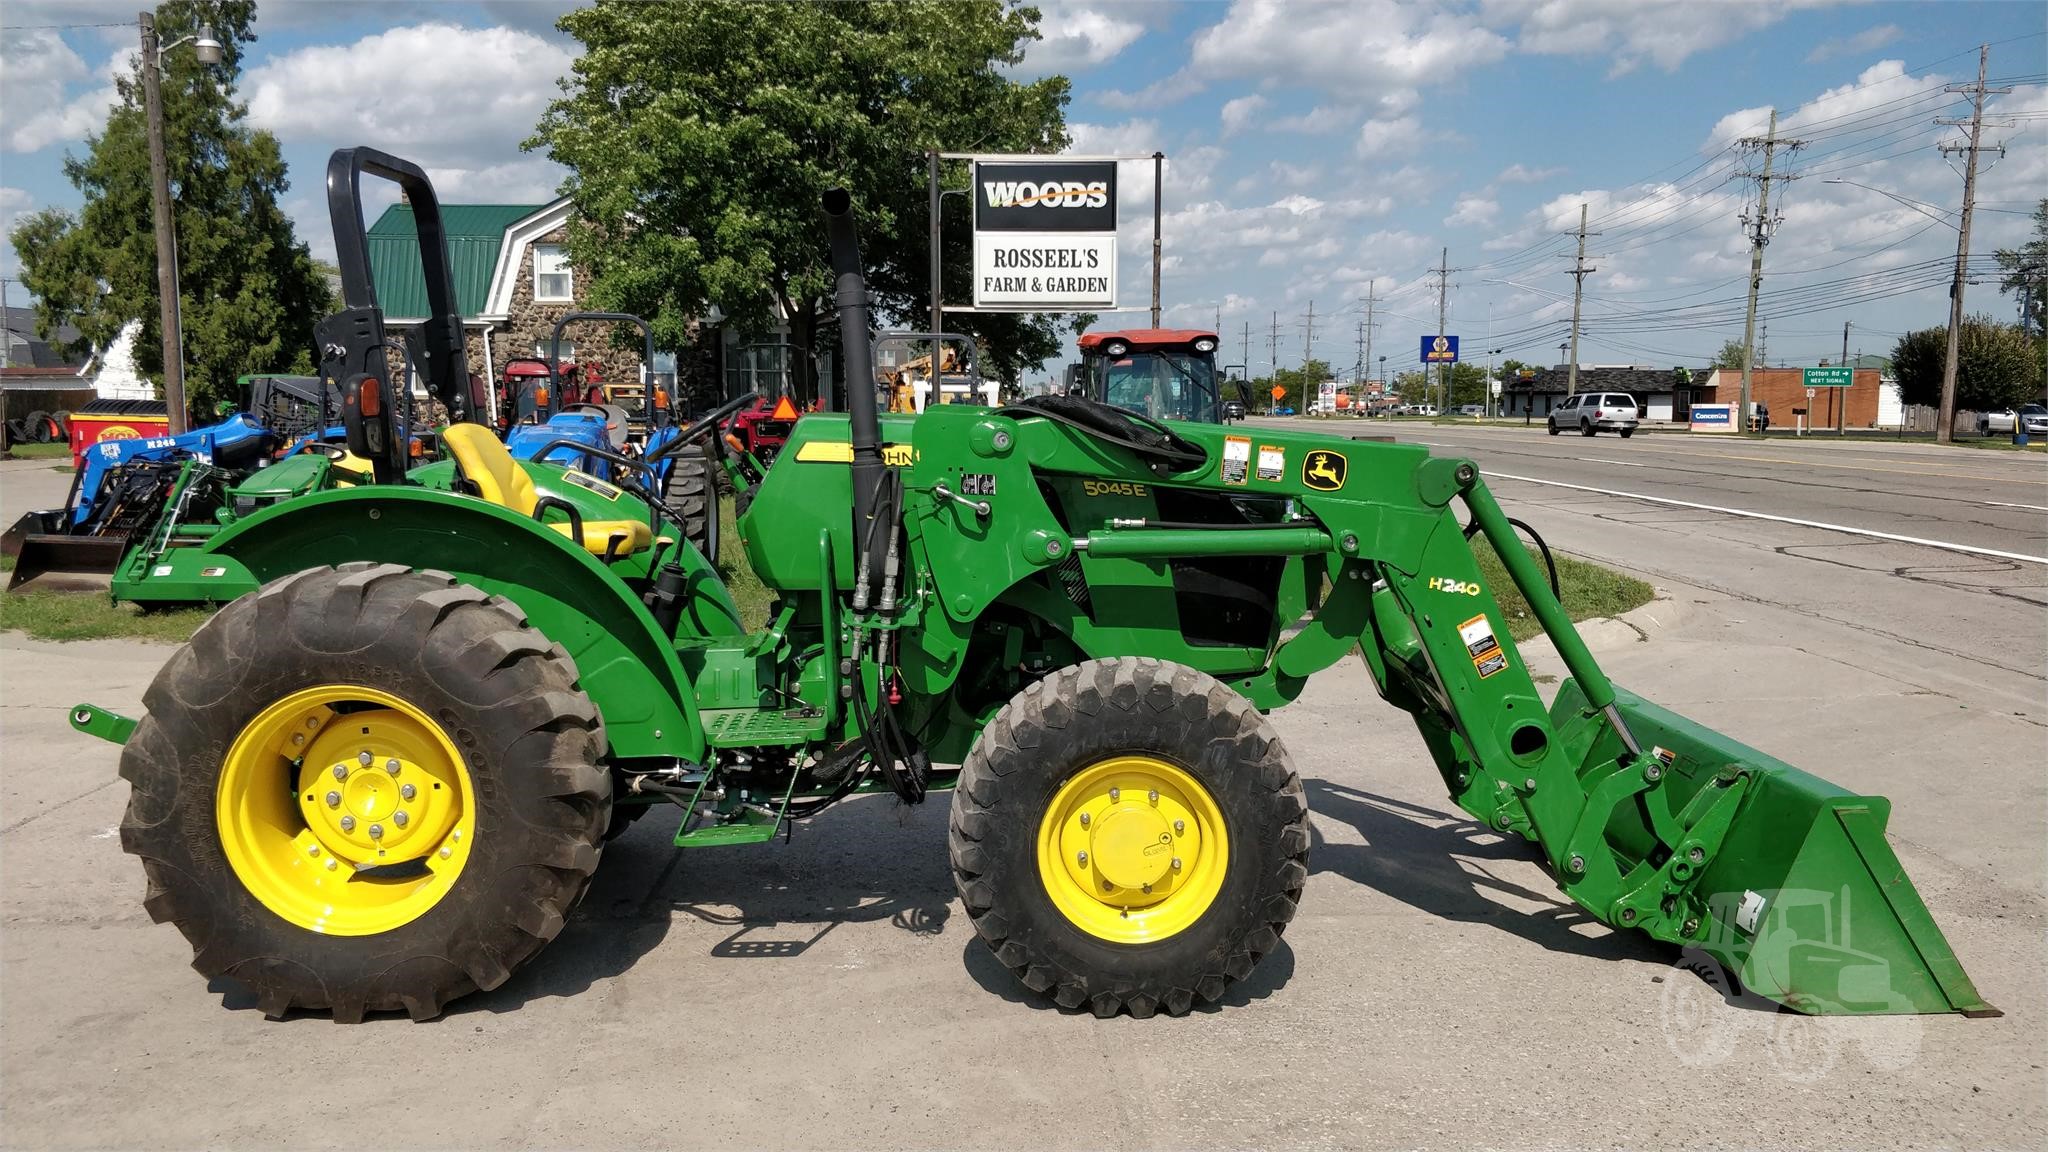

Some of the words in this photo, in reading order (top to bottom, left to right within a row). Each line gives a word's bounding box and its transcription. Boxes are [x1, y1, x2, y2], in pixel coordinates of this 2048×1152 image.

[984, 182, 1107, 208] WOODS
[993, 248, 1099, 268] ROSSEEL'S
[984, 277, 1027, 292] FARM
[1031, 277, 1043, 292] &
[1046, 277, 1108, 292] GARDEN
[1428, 577, 1480, 596] H240
